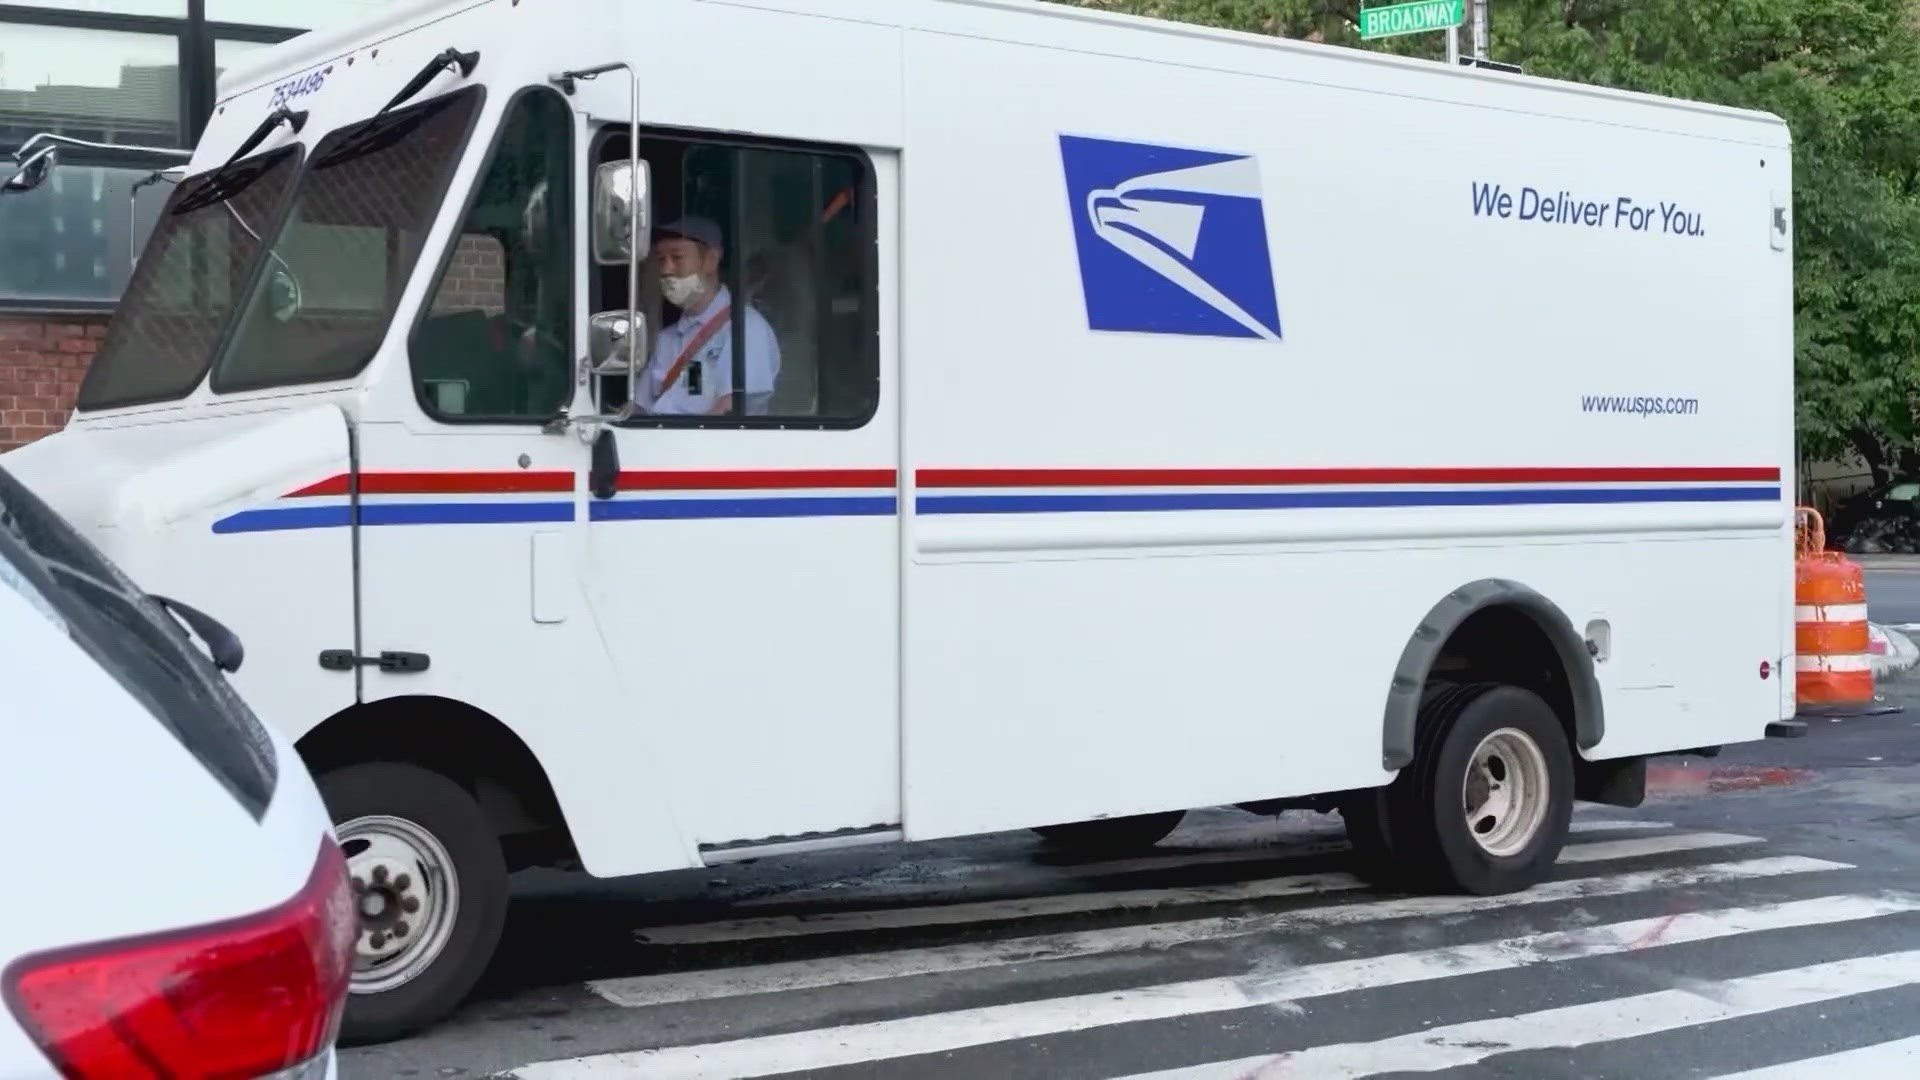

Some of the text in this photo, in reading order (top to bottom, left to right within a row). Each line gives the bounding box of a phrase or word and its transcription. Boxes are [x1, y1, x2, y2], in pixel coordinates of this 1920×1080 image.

[1367, 1, 1457, 35] BROADWAY
[1472, 181, 1705, 237] We Deliver For You.
[1581, 395, 1699, 419] www.usps.com
